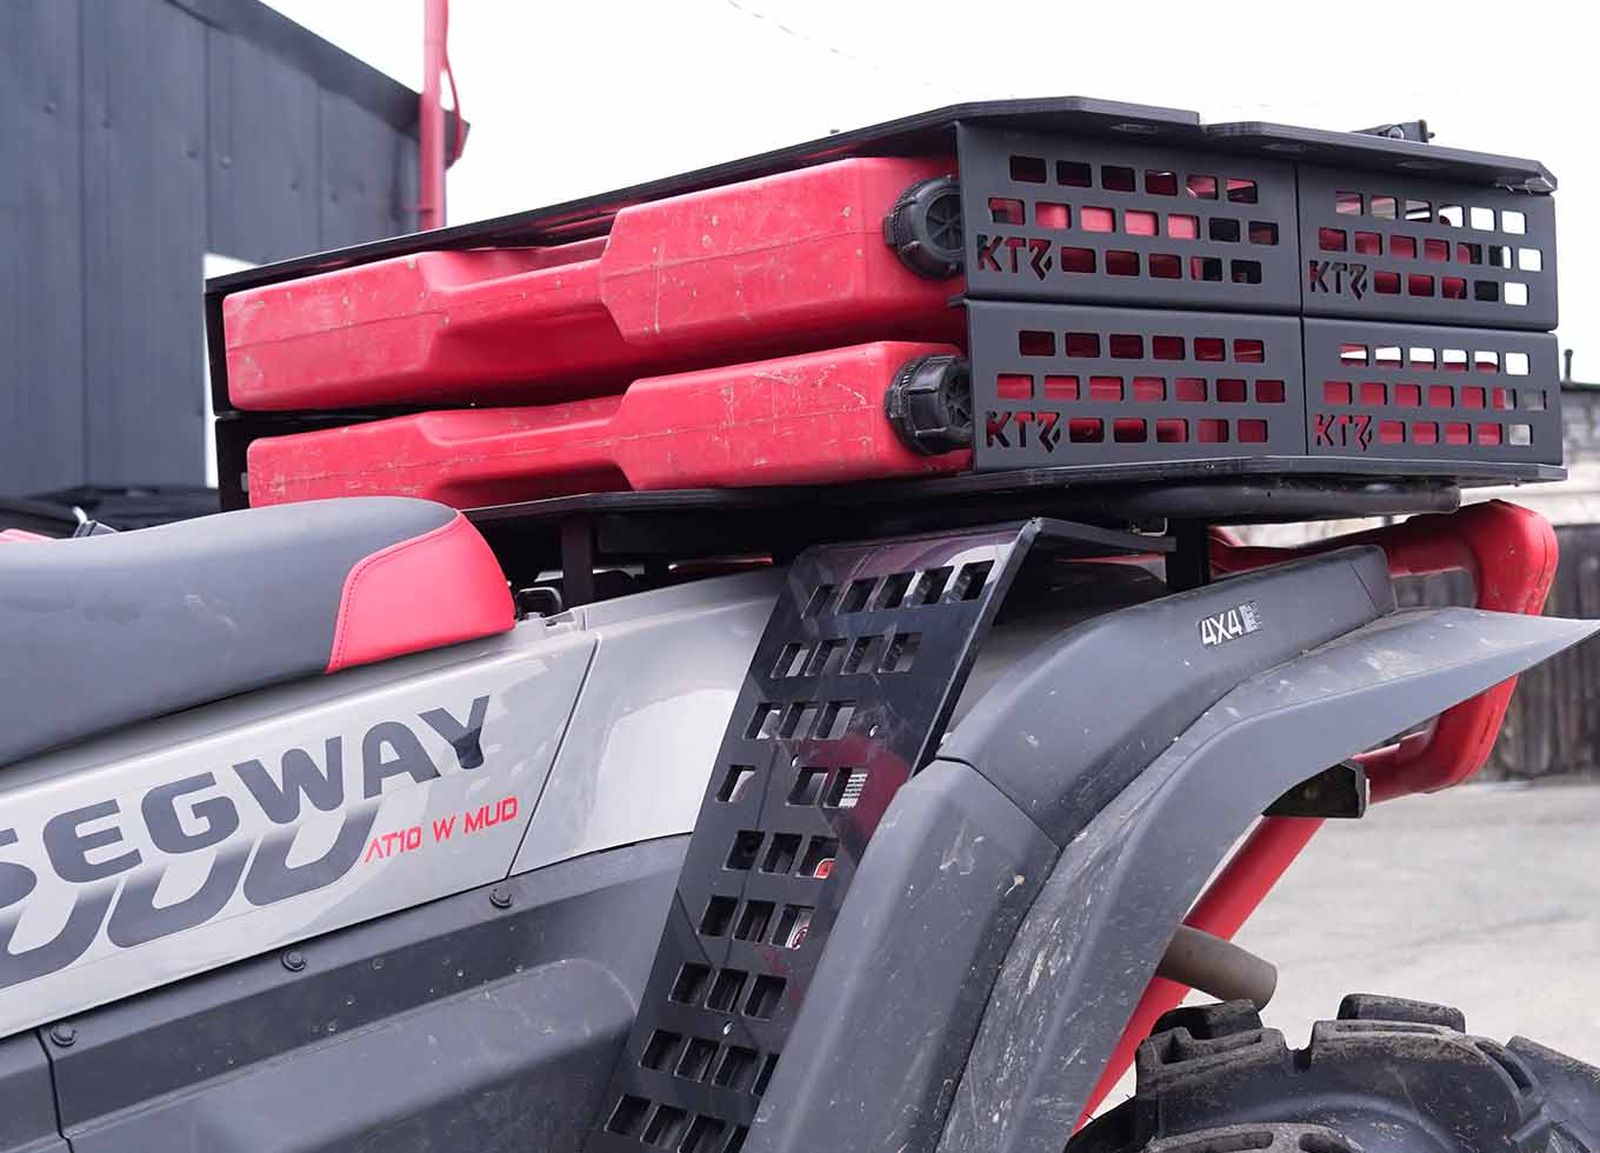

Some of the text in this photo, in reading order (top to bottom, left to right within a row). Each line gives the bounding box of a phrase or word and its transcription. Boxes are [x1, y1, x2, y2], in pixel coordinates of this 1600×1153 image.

[364, 796, 518, 863] AT10 W MUD
